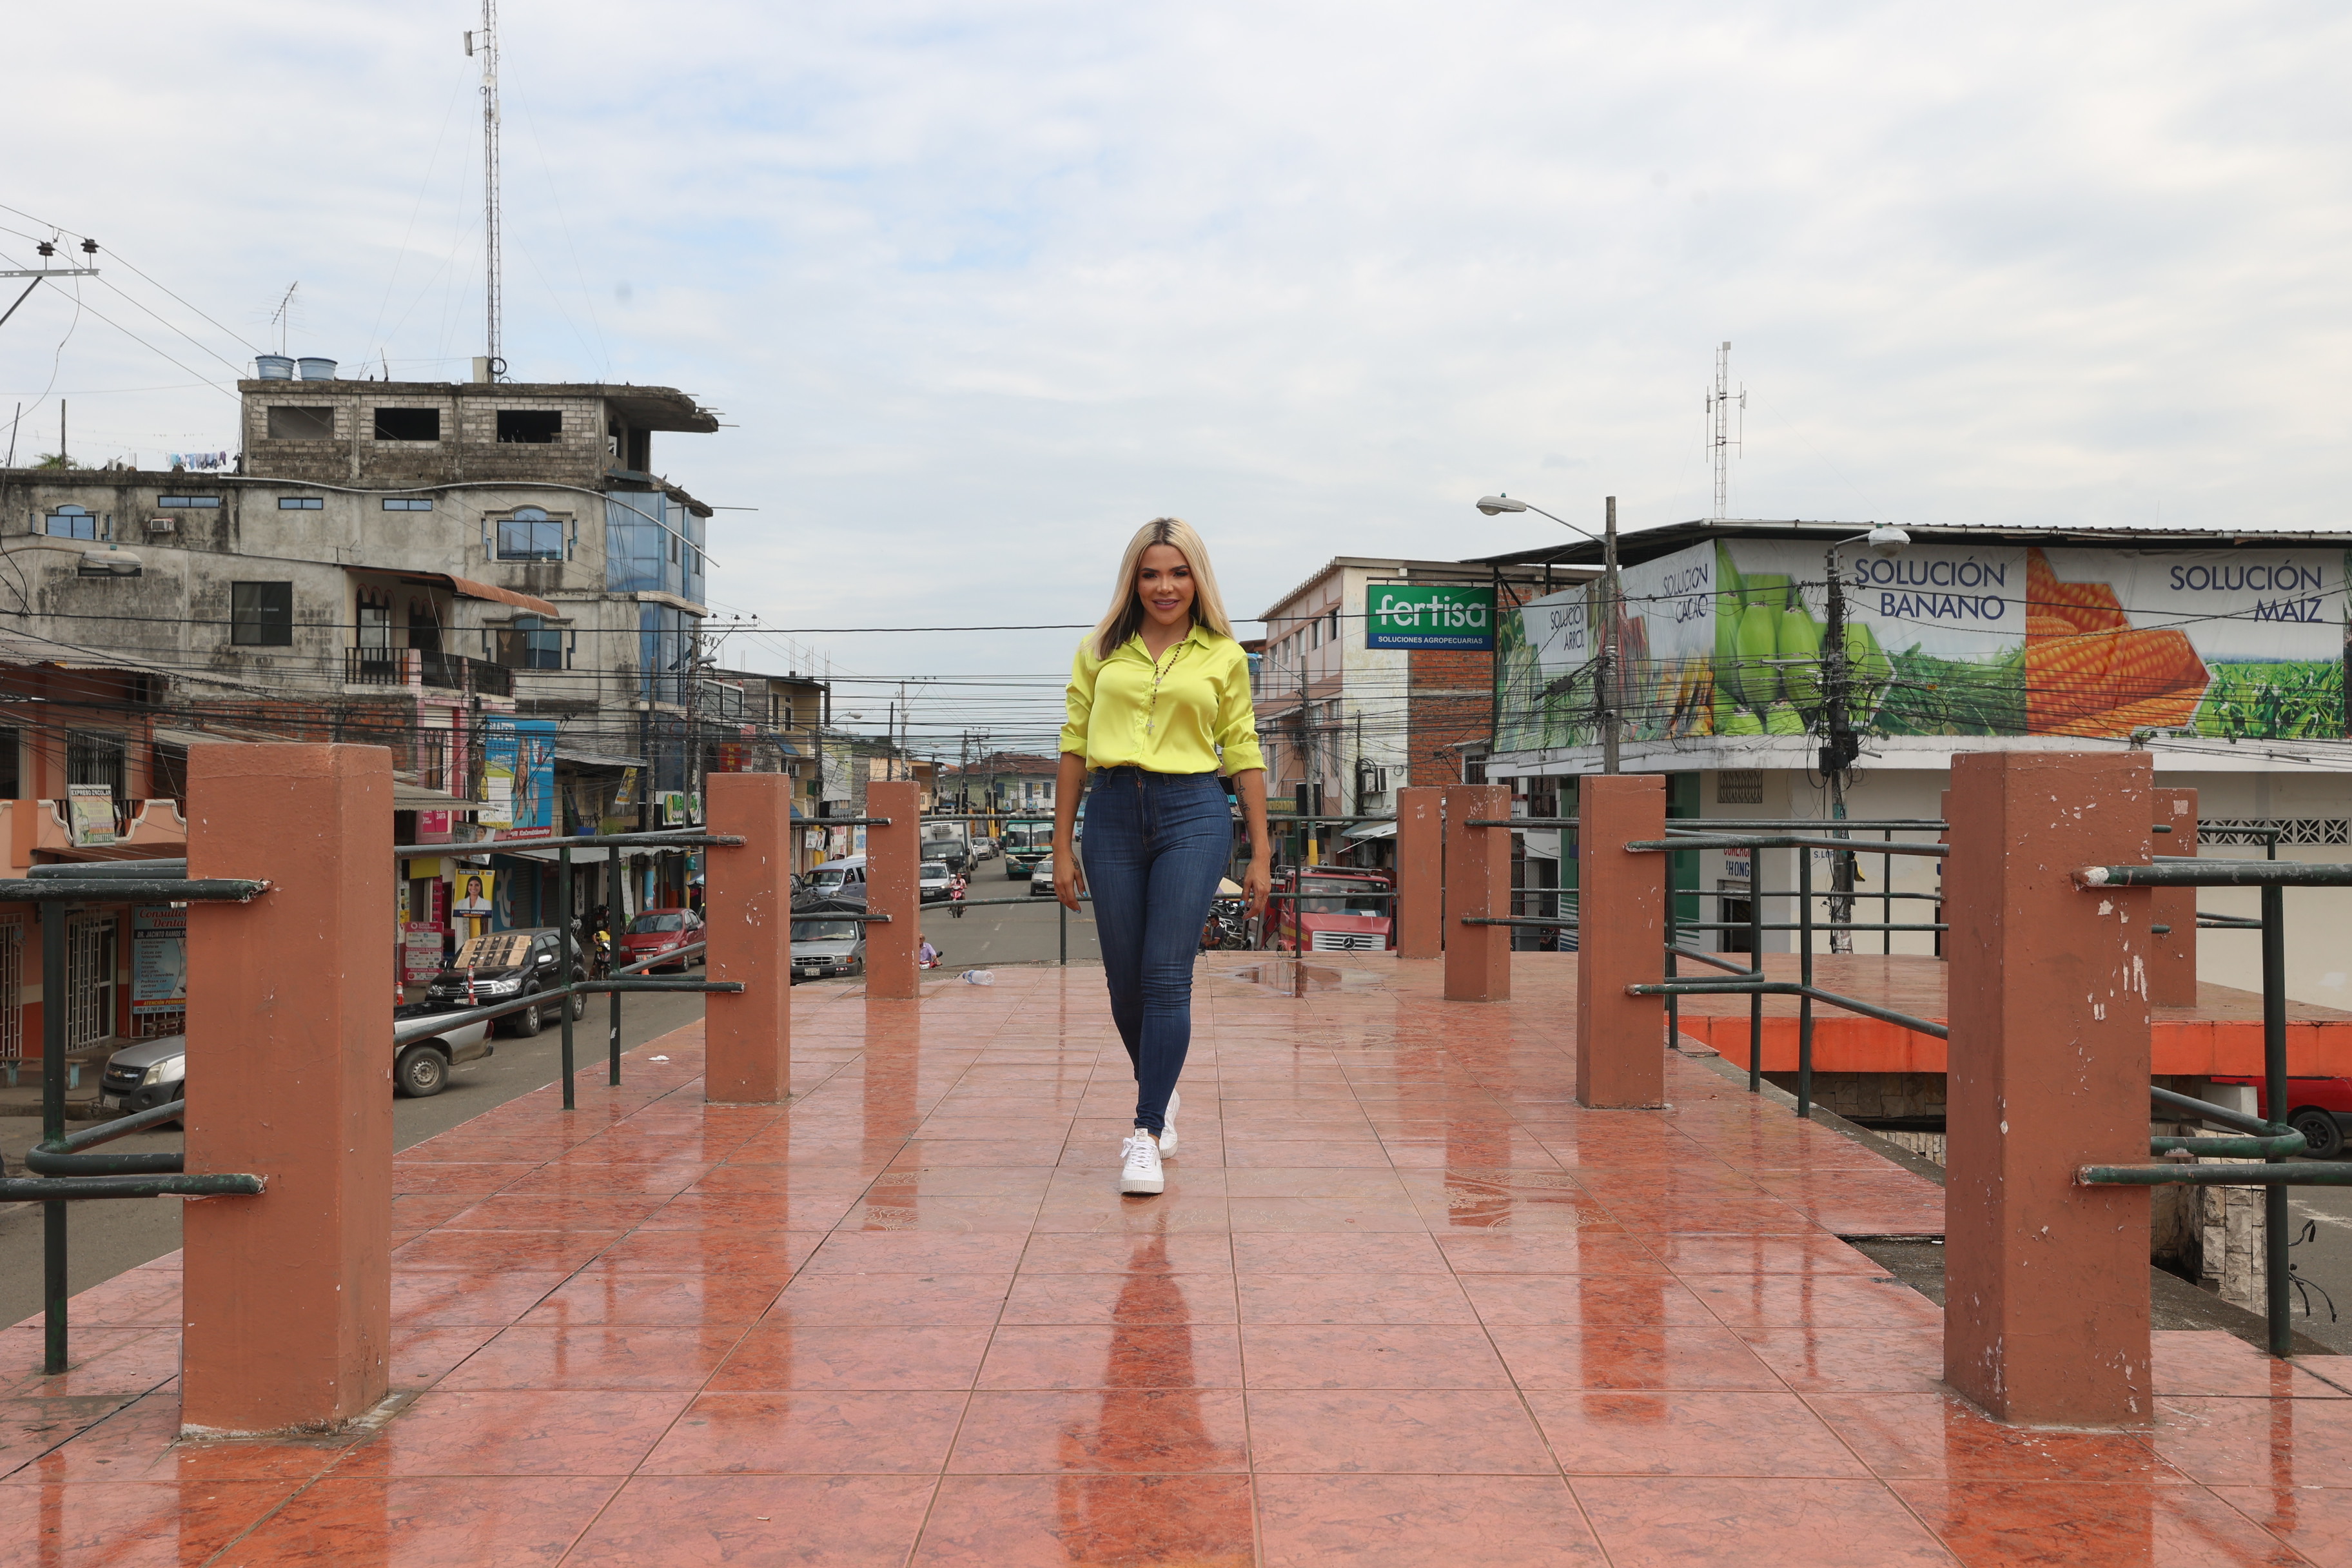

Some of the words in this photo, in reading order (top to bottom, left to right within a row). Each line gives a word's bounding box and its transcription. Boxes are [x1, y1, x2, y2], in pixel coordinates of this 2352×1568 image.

[1855, 556, 2004, 587] SOLUCIÓN
[2170, 560, 2322, 591] SOLUCIÓN
[1375, 594, 1486, 627] fertisa
[1676, 594, 1708, 623] CACAO
[1881, 593, 2004, 620] BANANO
[2254, 592, 2322, 622] MAÍZ
